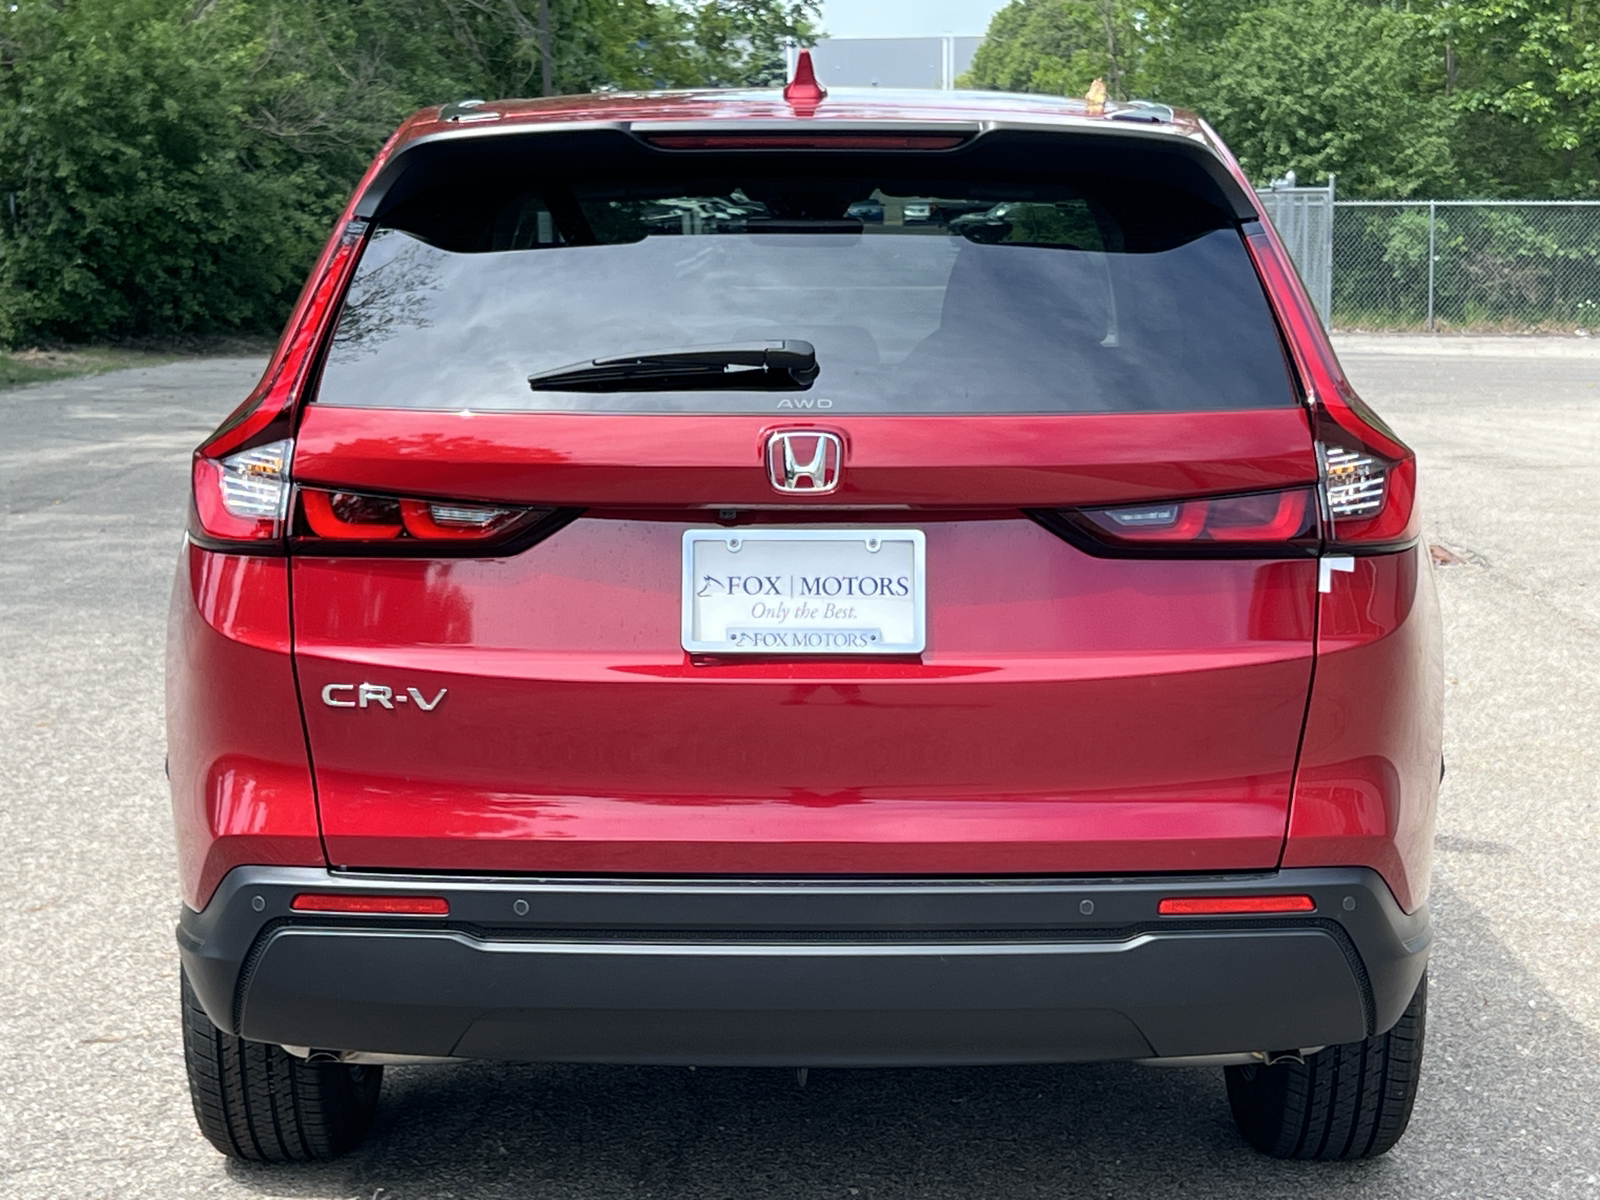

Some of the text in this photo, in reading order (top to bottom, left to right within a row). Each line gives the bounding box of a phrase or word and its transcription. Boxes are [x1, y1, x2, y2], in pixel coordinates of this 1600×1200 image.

[777, 399, 833, 409] AWD
[727, 576, 909, 597] FOX MOTORS
[751, 602, 858, 624] Only the Best.
[754, 632, 868, 648] FOX MOTORS
[321, 682, 448, 711] CR-V
